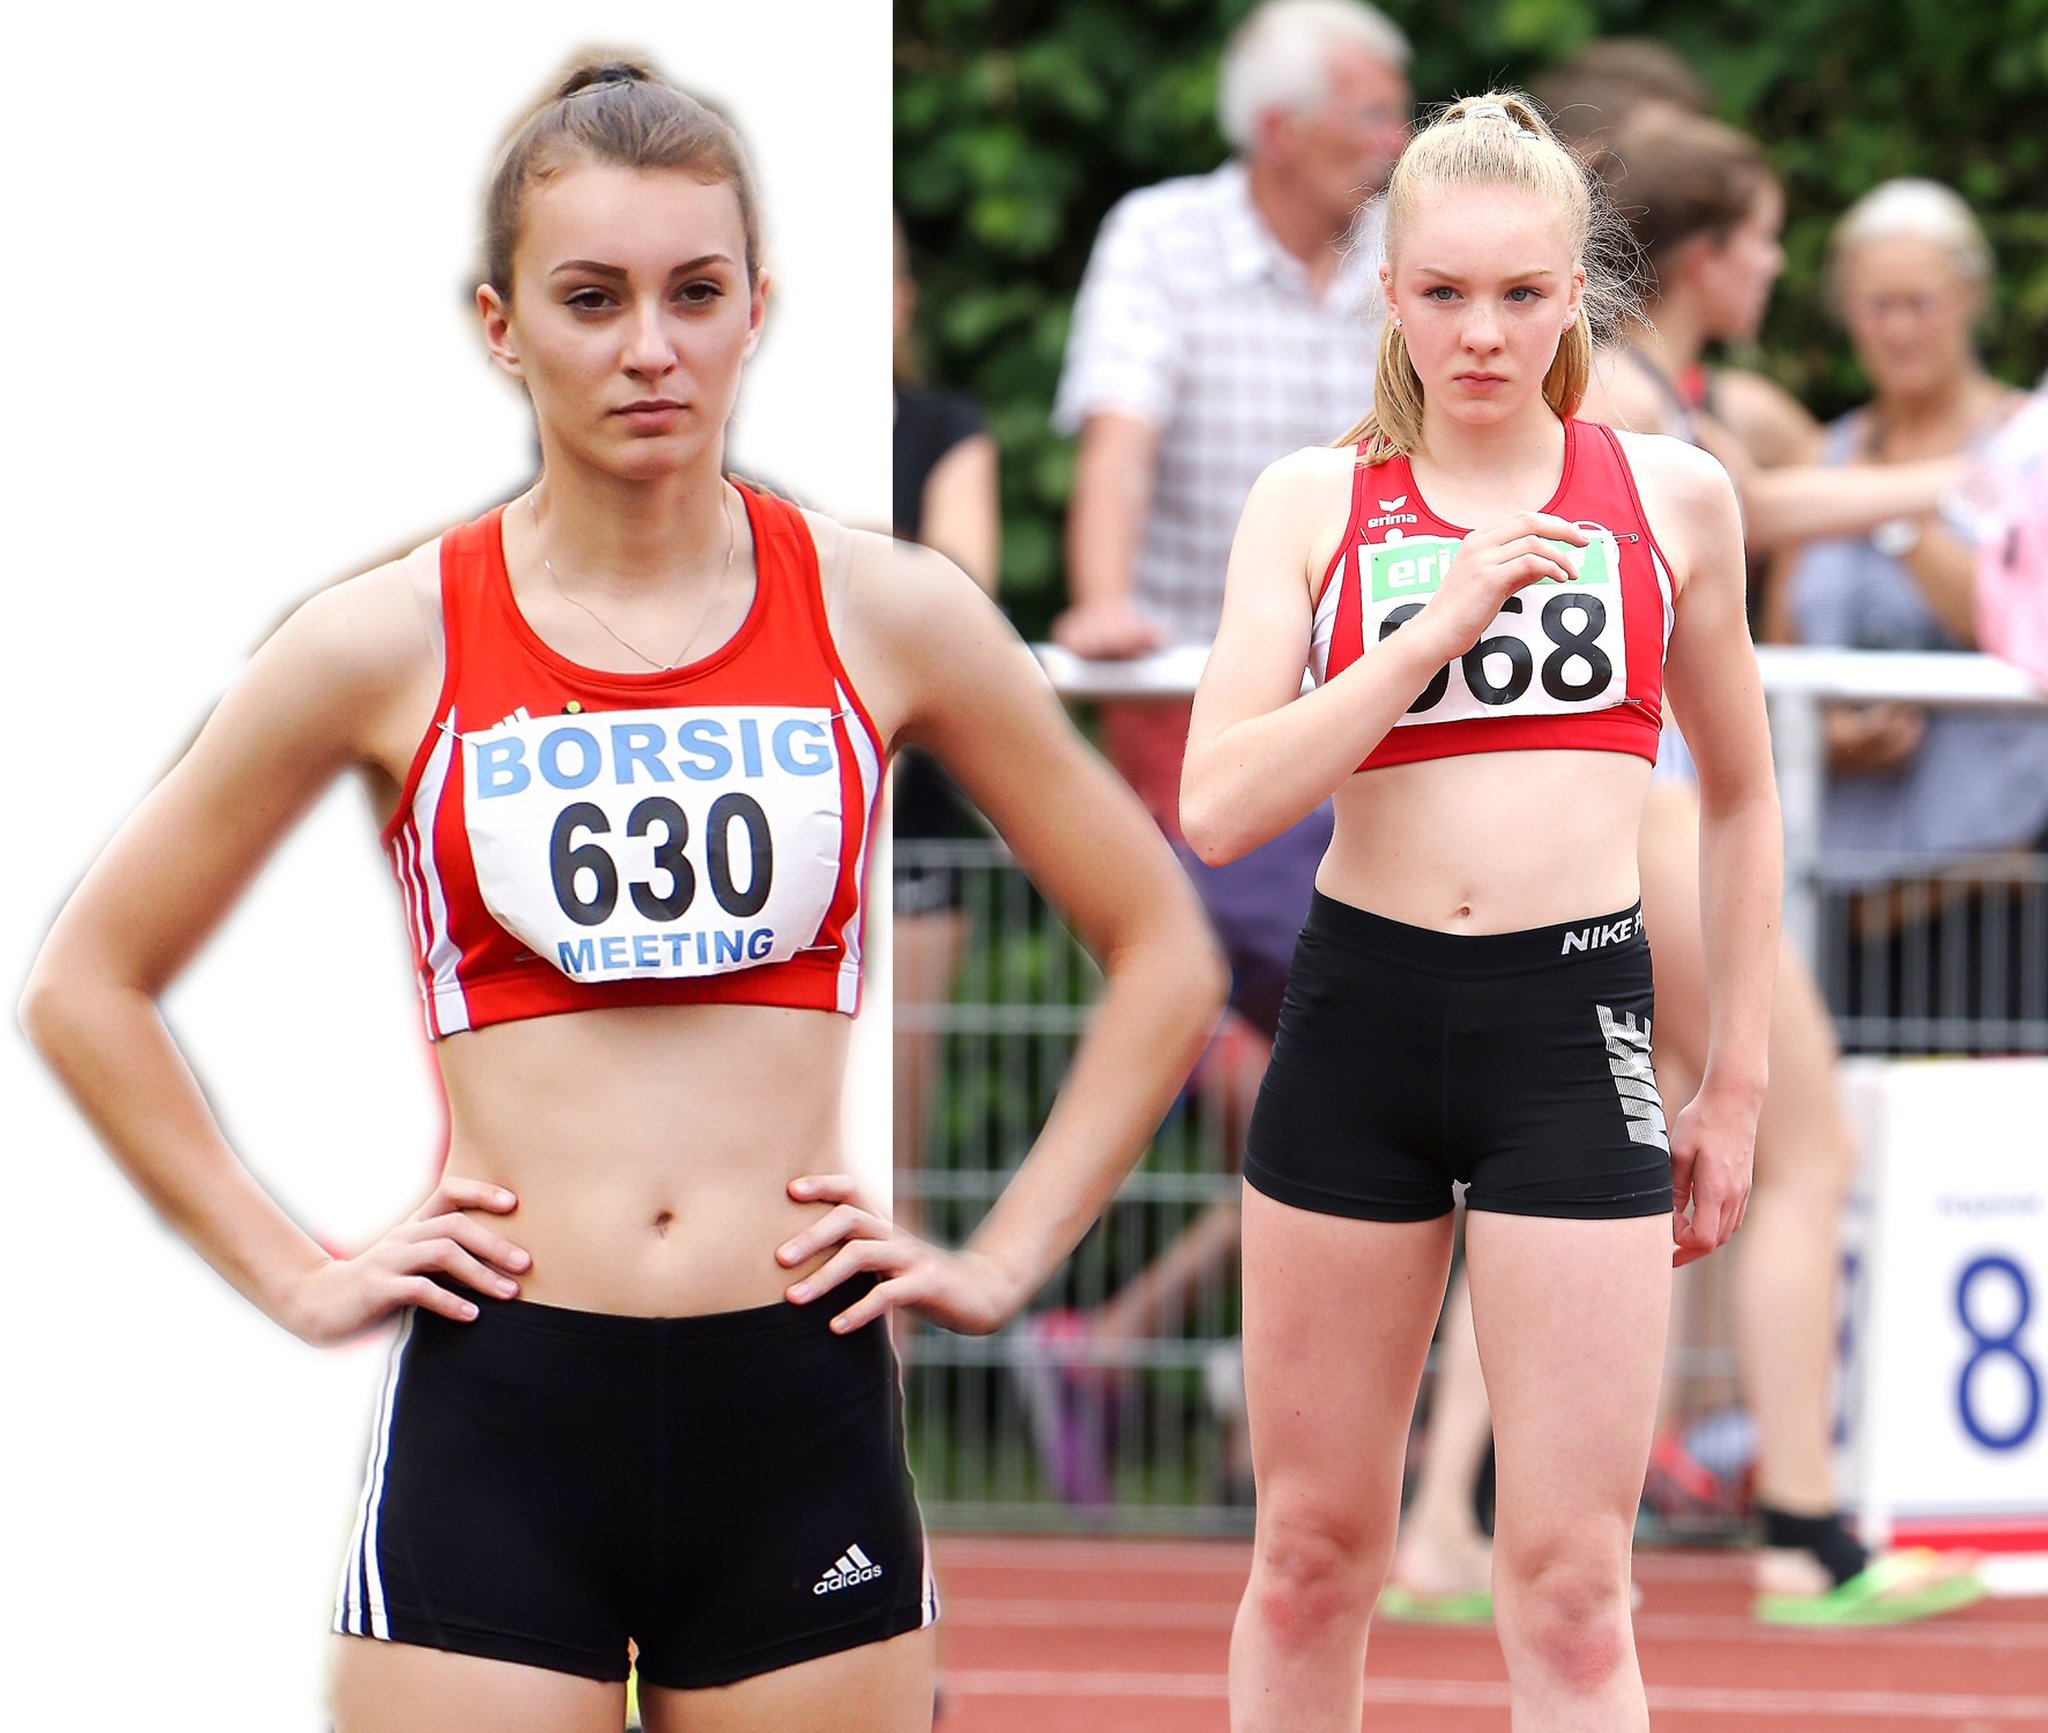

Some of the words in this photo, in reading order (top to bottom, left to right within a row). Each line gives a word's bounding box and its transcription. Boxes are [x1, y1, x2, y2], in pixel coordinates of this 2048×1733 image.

[1367, 511, 1418, 529] erima
[1387, 547, 1455, 589] eri
[476, 719, 835, 799] BORSIG
[549, 792, 774, 926] 630
[557, 928, 775, 974] MEETING
[1561, 917, 1633, 956] NIKE
[1596, 1004, 1671, 1157] NIKE
[1956, 1252, 2042, 1453] 8
[813, 1564, 882, 1595] adidas
